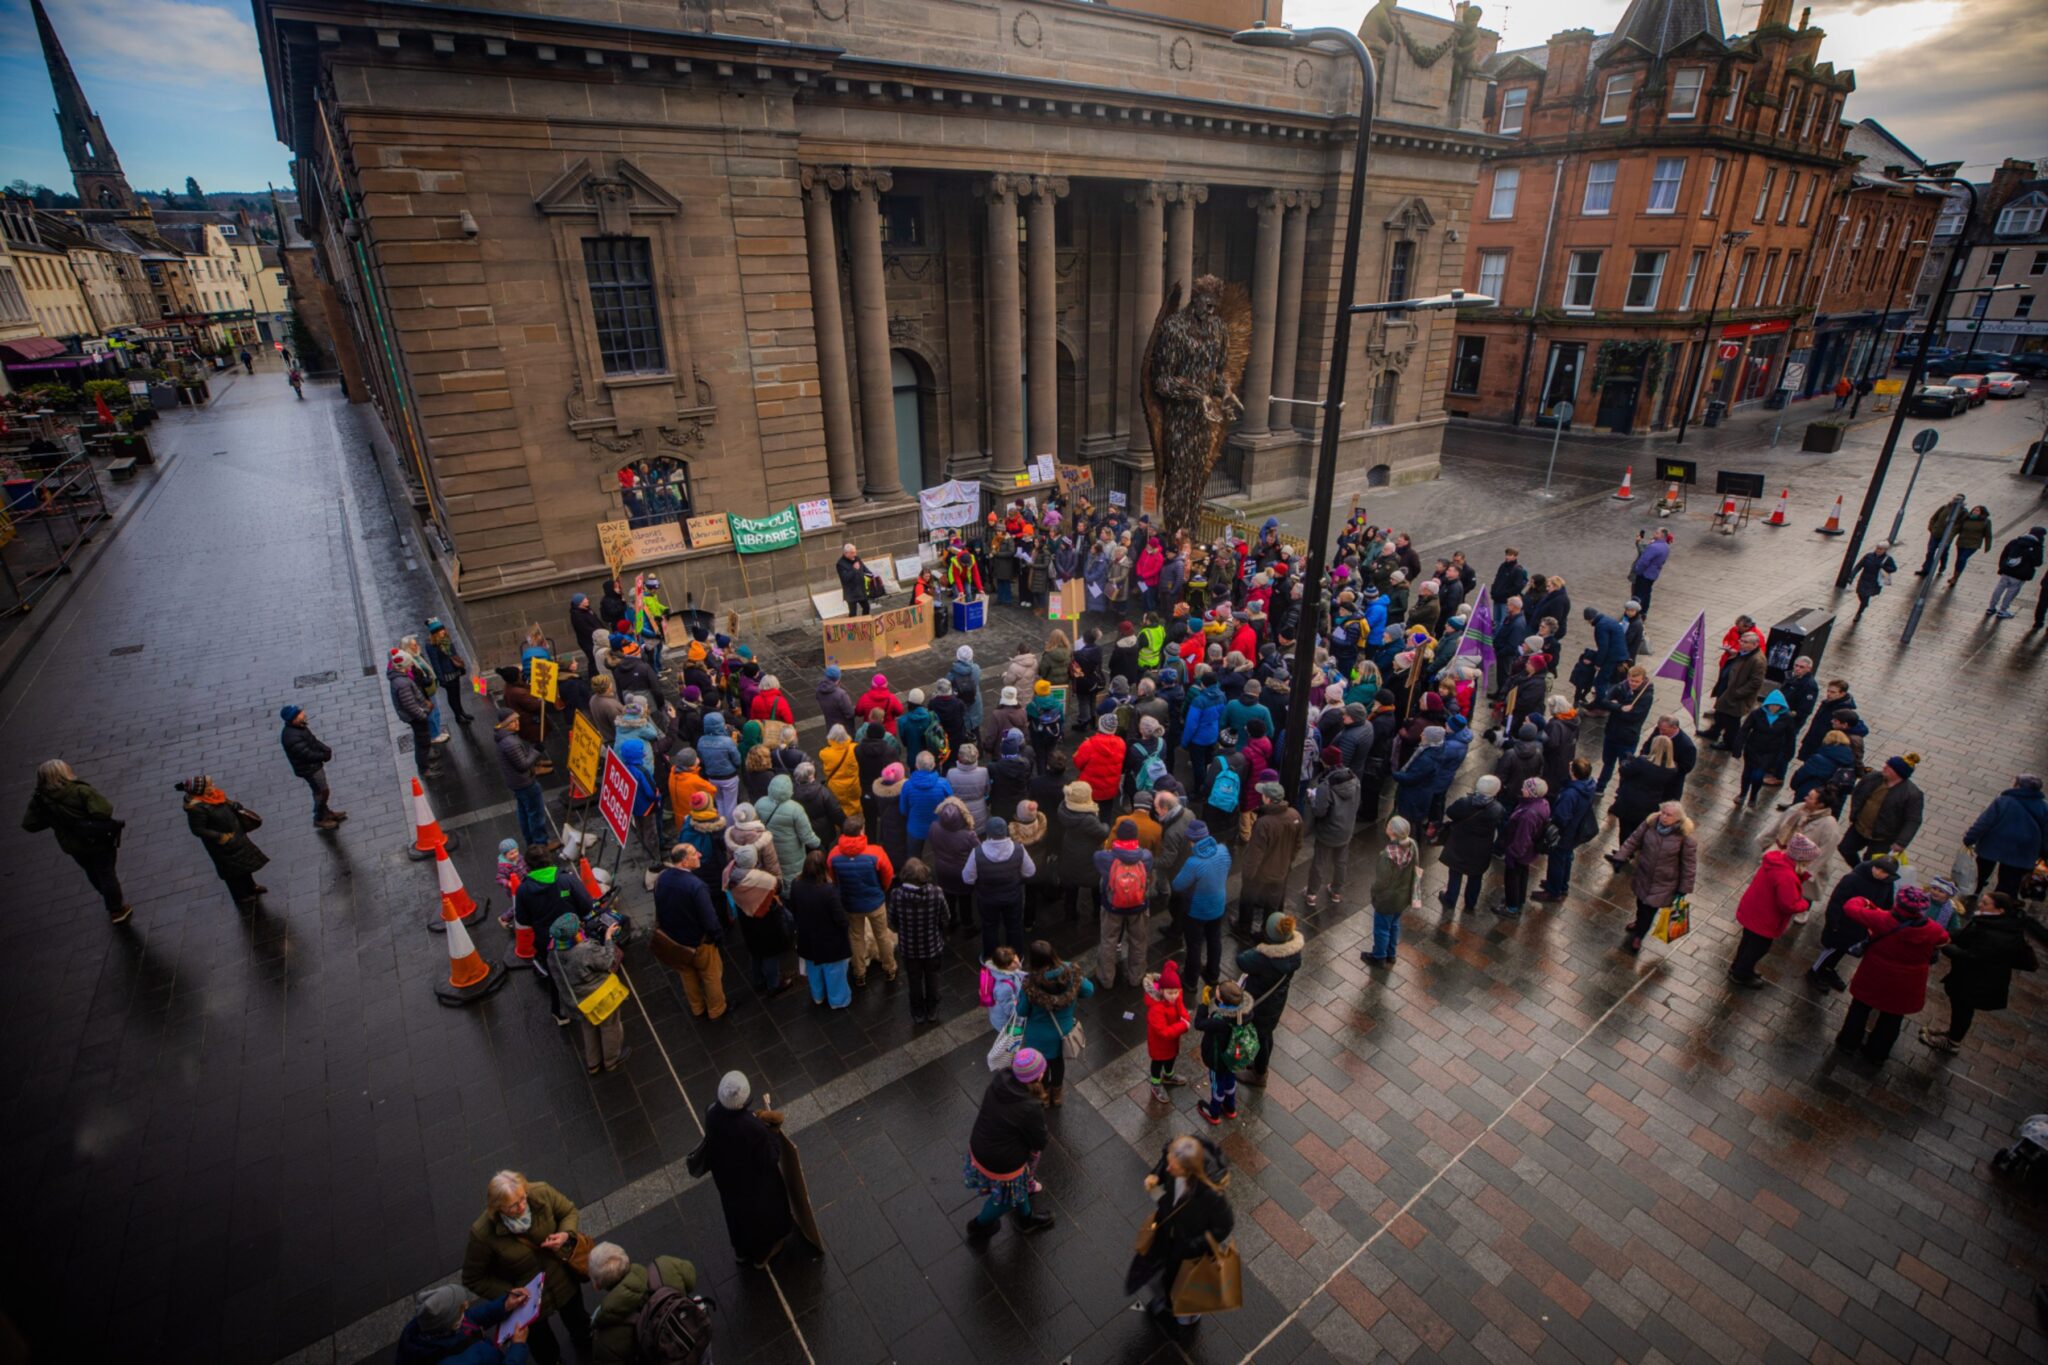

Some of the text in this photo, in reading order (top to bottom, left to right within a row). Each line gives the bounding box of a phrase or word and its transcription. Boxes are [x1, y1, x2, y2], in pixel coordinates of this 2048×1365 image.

[600, 521, 626, 534] SAVE
[768, 510, 795, 527] OUR
[736, 526, 797, 545] LIBRARIES
[609, 765, 630, 801] ROAD
[602, 784, 628, 832] CLOSED
